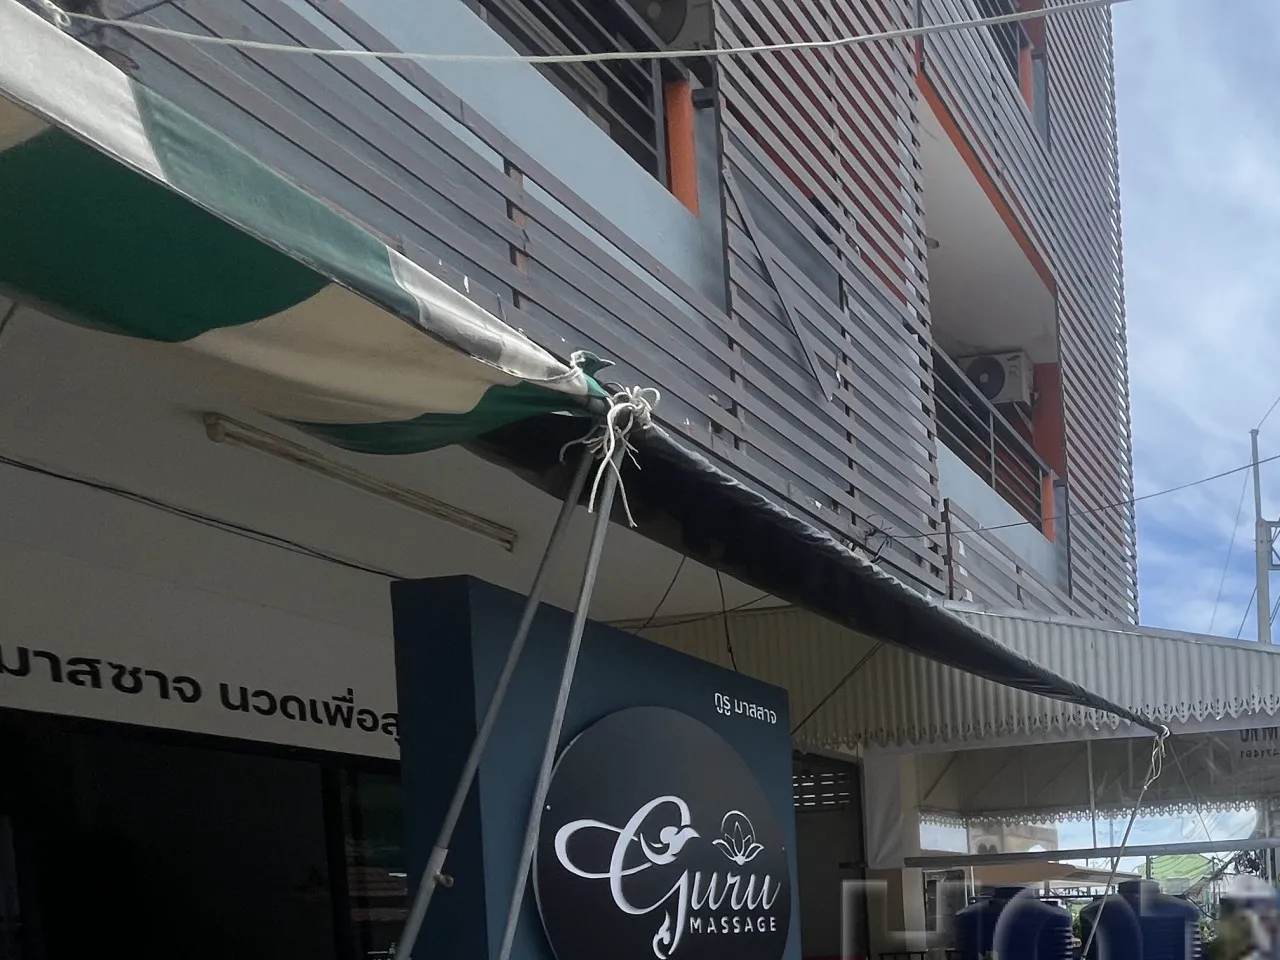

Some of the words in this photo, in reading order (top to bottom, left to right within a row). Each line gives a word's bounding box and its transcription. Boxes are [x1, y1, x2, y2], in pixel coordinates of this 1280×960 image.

[714, 692, 731, 716] กูรู
[554, 795, 781, 959] Guru
[689, 916, 777, 934] MASSAGE
